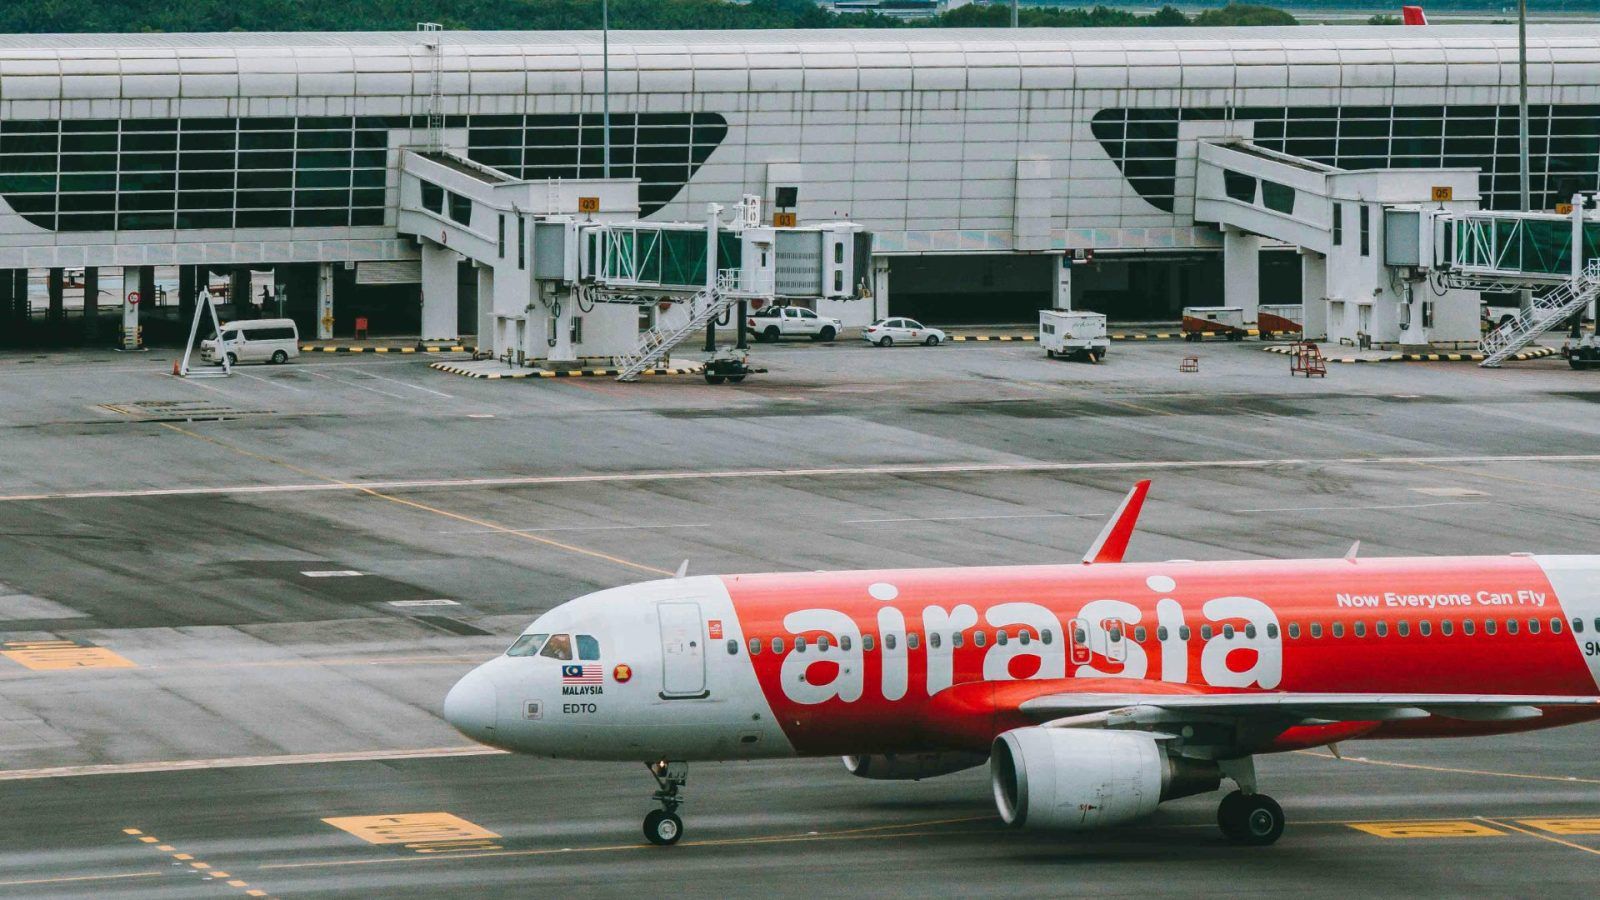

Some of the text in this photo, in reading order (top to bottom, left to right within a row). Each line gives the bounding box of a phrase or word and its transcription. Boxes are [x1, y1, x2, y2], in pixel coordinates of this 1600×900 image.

[1436, 189, 1448, 198] Q5
[583, 200, 595, 209] Q3
[1336, 589, 1546, 609] Now Everyone Can Fly
[780, 575, 1283, 705] airasia
[562, 686, 603, 695] MALAYSIA
[563, 703, 597, 713] EDTO
